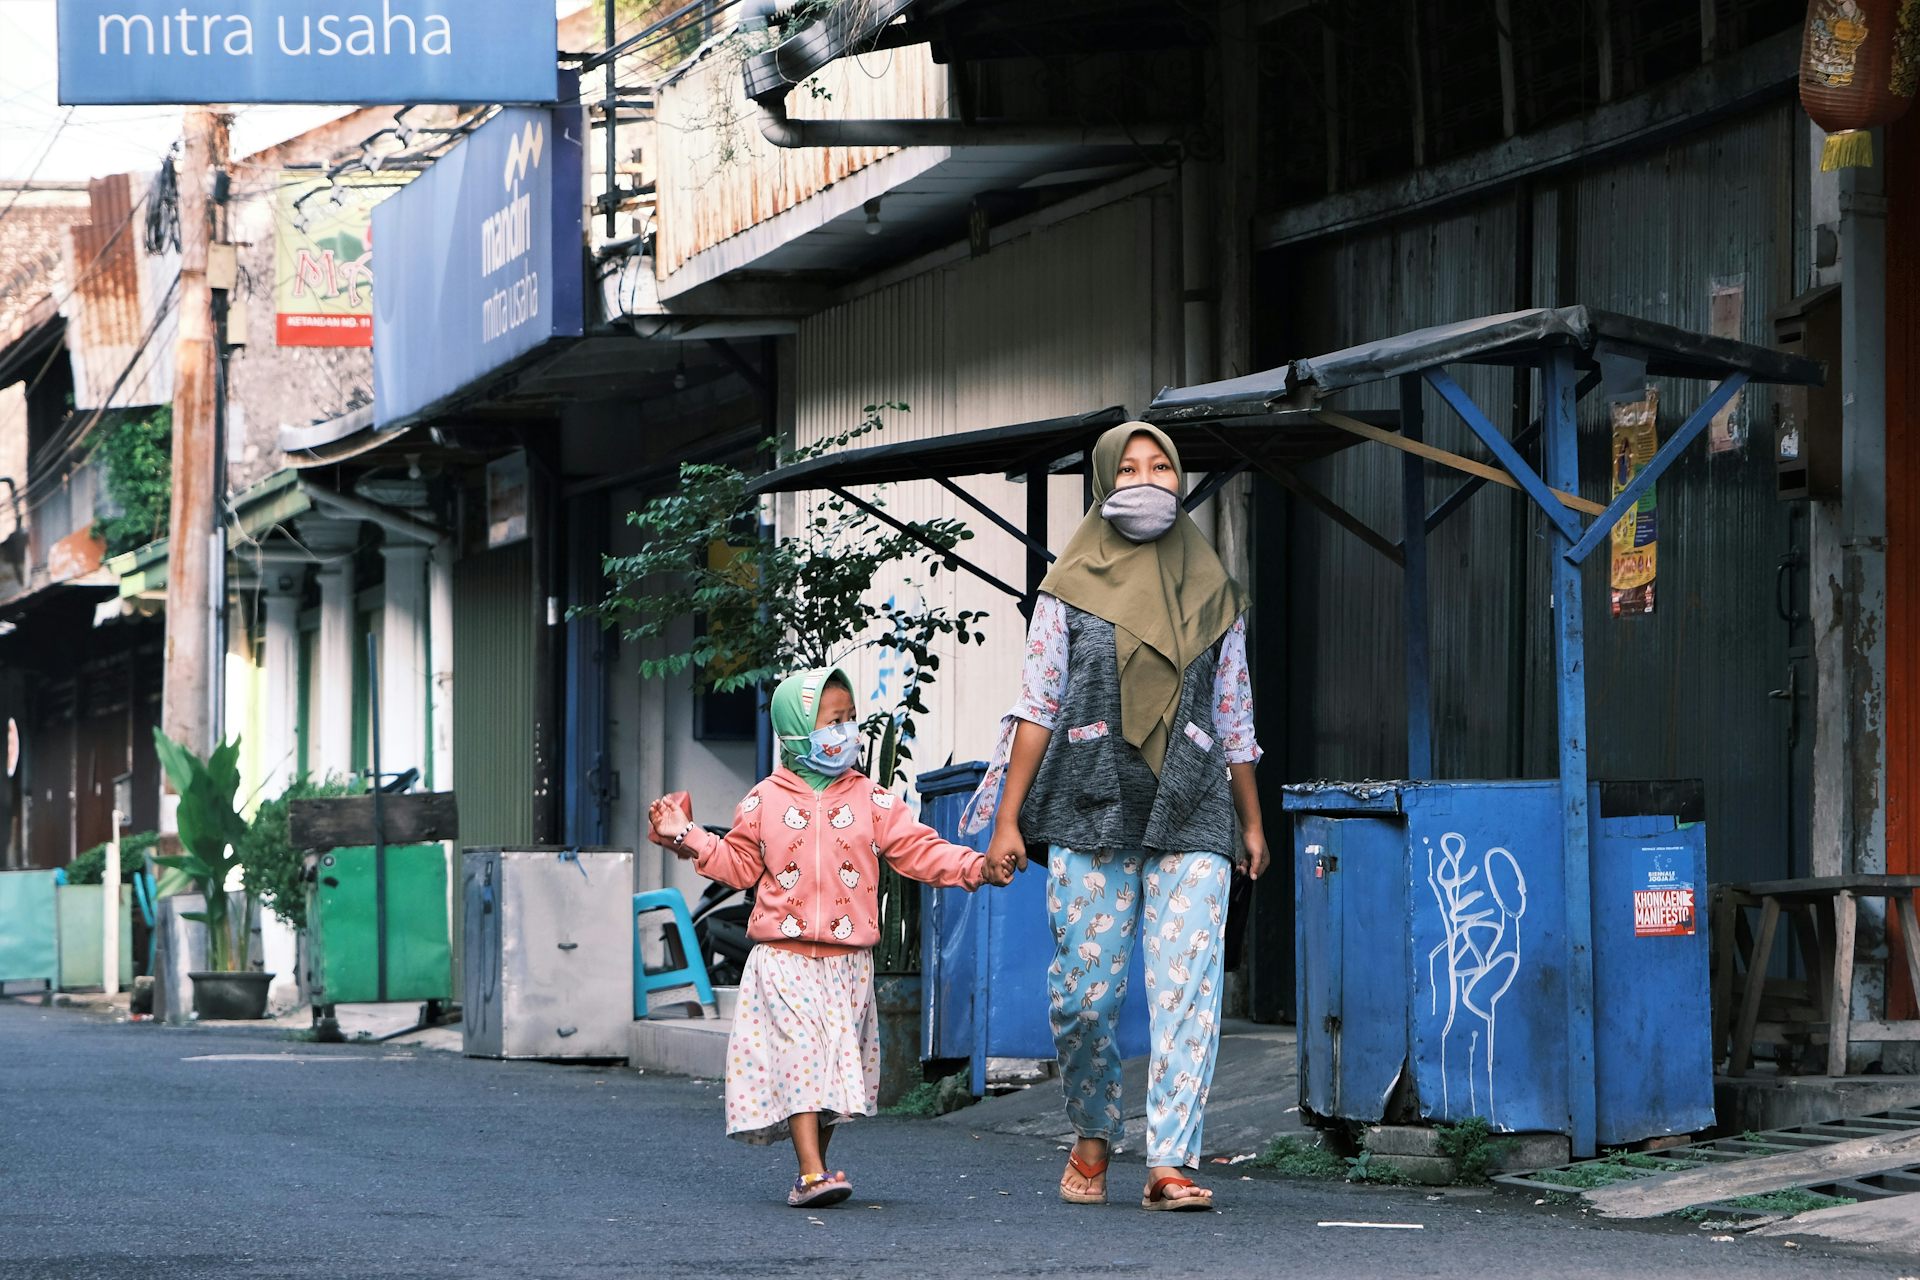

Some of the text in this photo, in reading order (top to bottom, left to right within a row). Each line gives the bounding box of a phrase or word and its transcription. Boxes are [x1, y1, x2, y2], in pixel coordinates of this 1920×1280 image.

[99, 0, 452, 56] mitra usaha
[483, 258, 538, 343] mitra usaha
[788, 838, 805, 852] HK
[835, 837, 851, 852] HK
[786, 896, 804, 907] HK
[835, 897, 851, 906] HK
